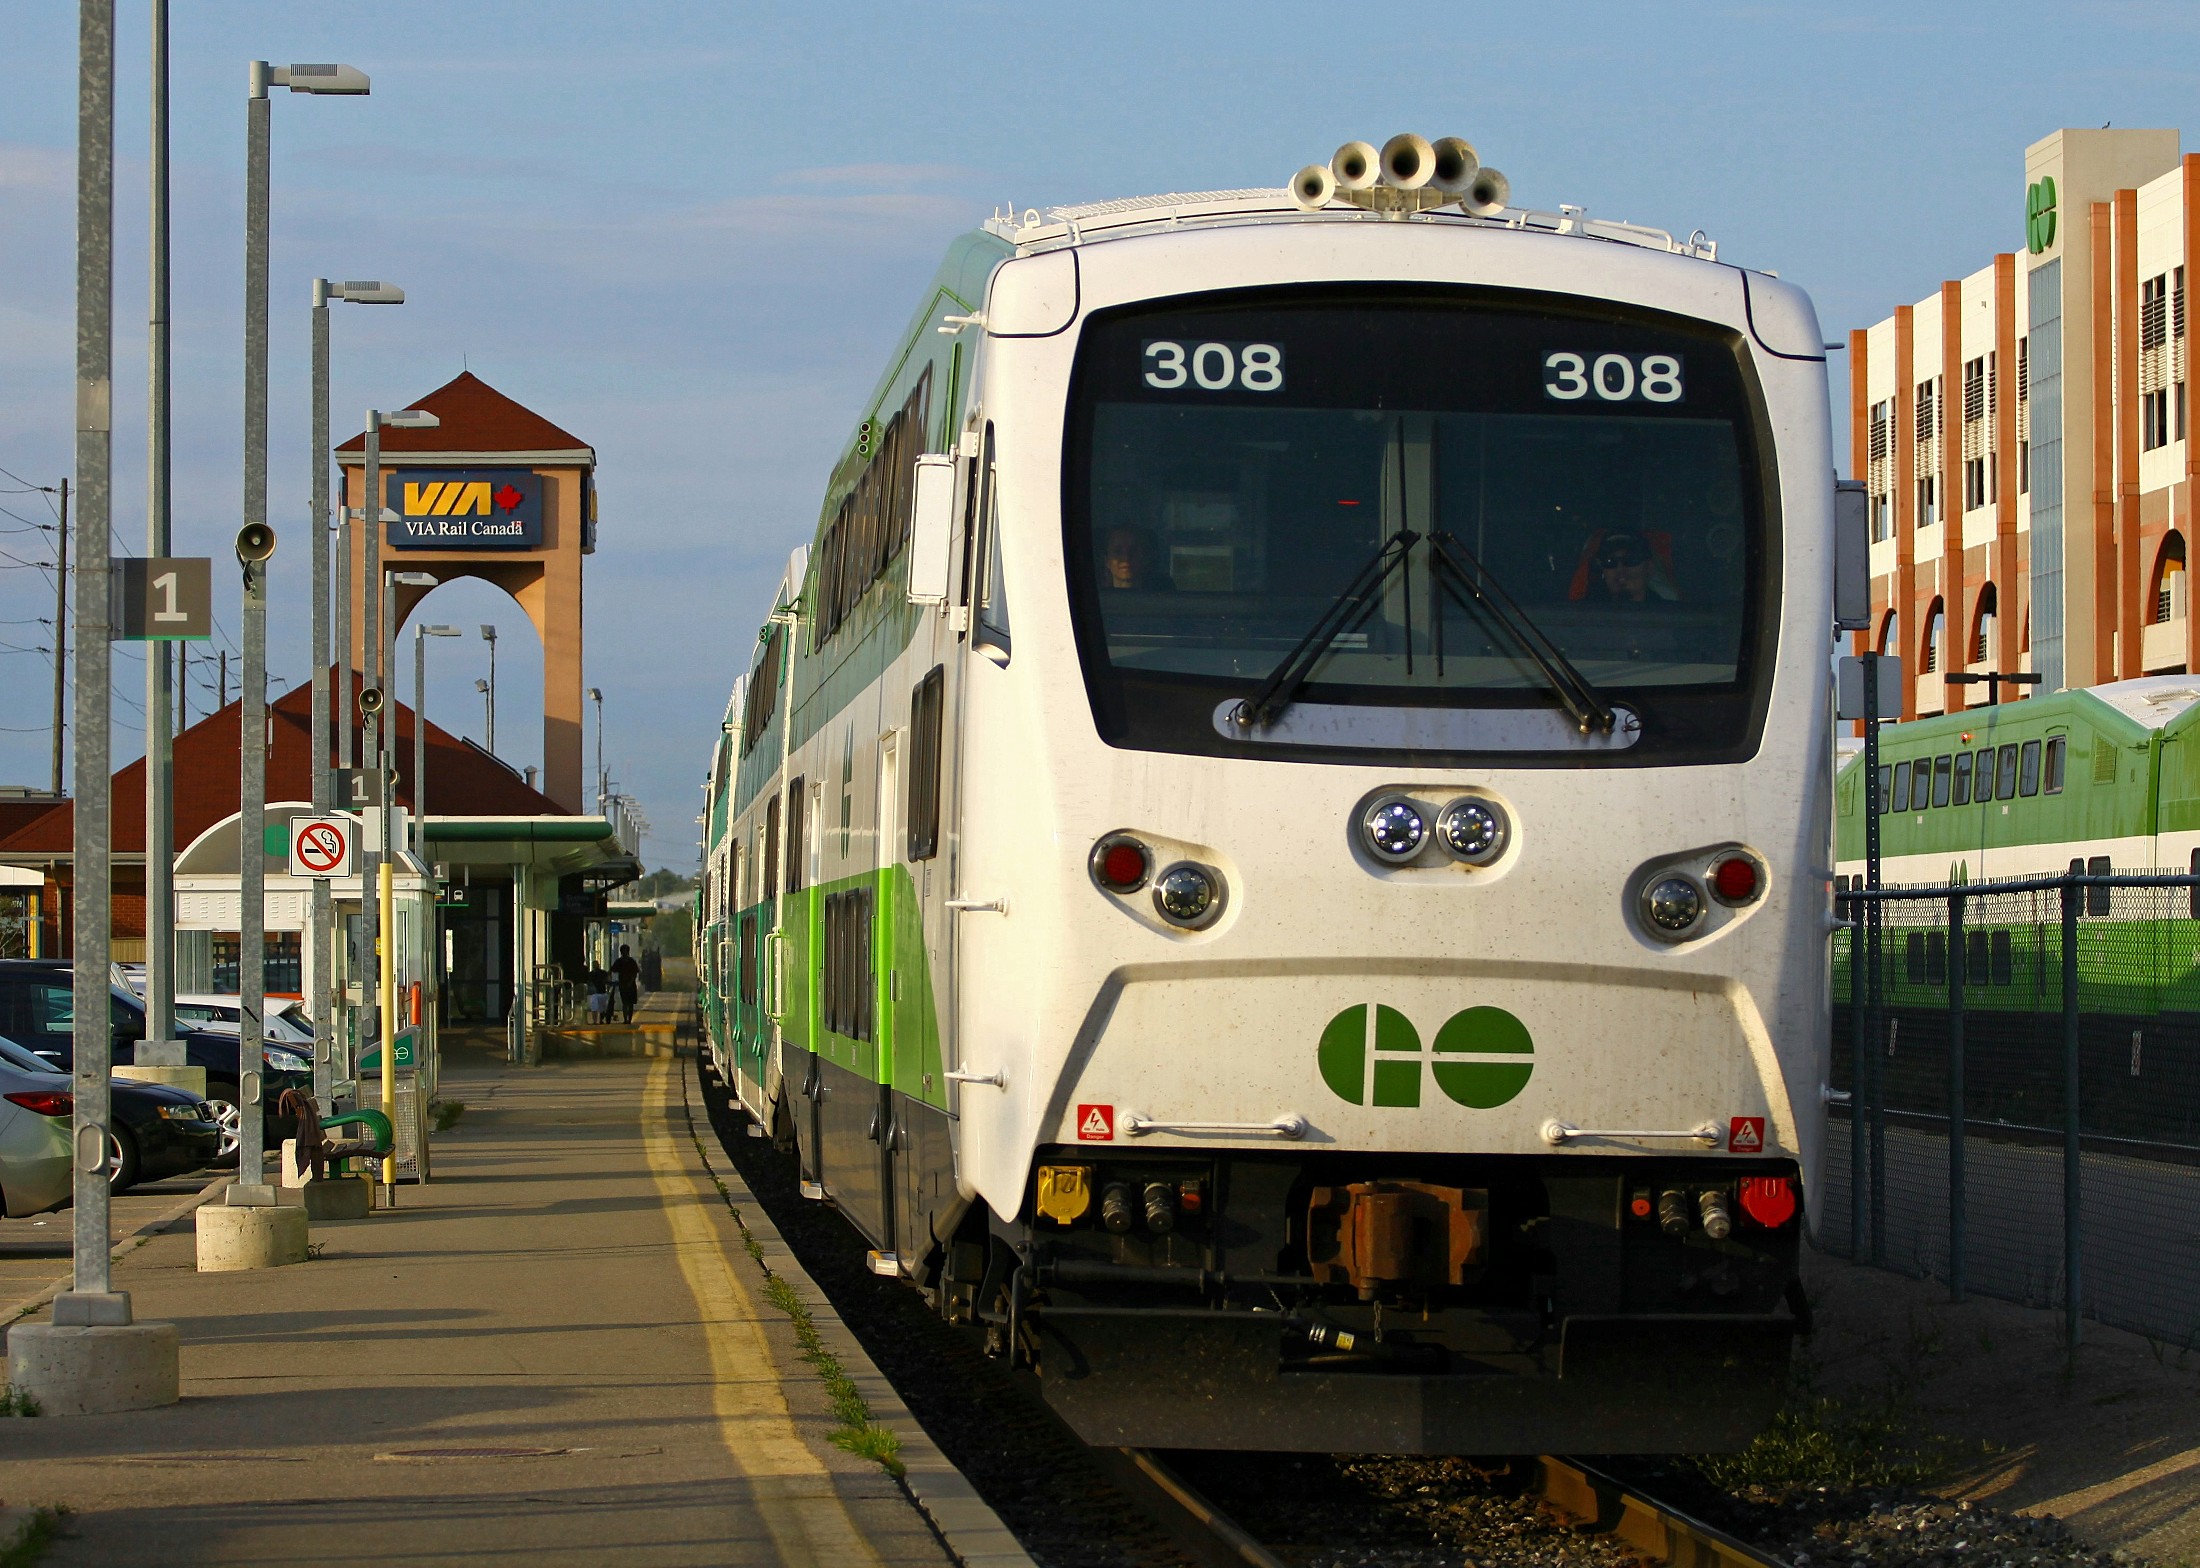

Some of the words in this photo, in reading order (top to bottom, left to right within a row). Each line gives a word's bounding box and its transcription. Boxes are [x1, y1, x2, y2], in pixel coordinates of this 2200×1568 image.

[1144, 341, 1283, 391] 308
[1545, 352, 1683, 402] 308
[404, 482, 492, 516] VIA
[406, 521, 436, 536] VIA
[438, 520, 467, 536] Rail
[471, 520, 524, 536] Canada
[153, 572, 188, 622] 1
[351, 775, 370, 801] 1
[433, 864, 444, 878] 1
[1317, 1002, 1535, 1110] GO
